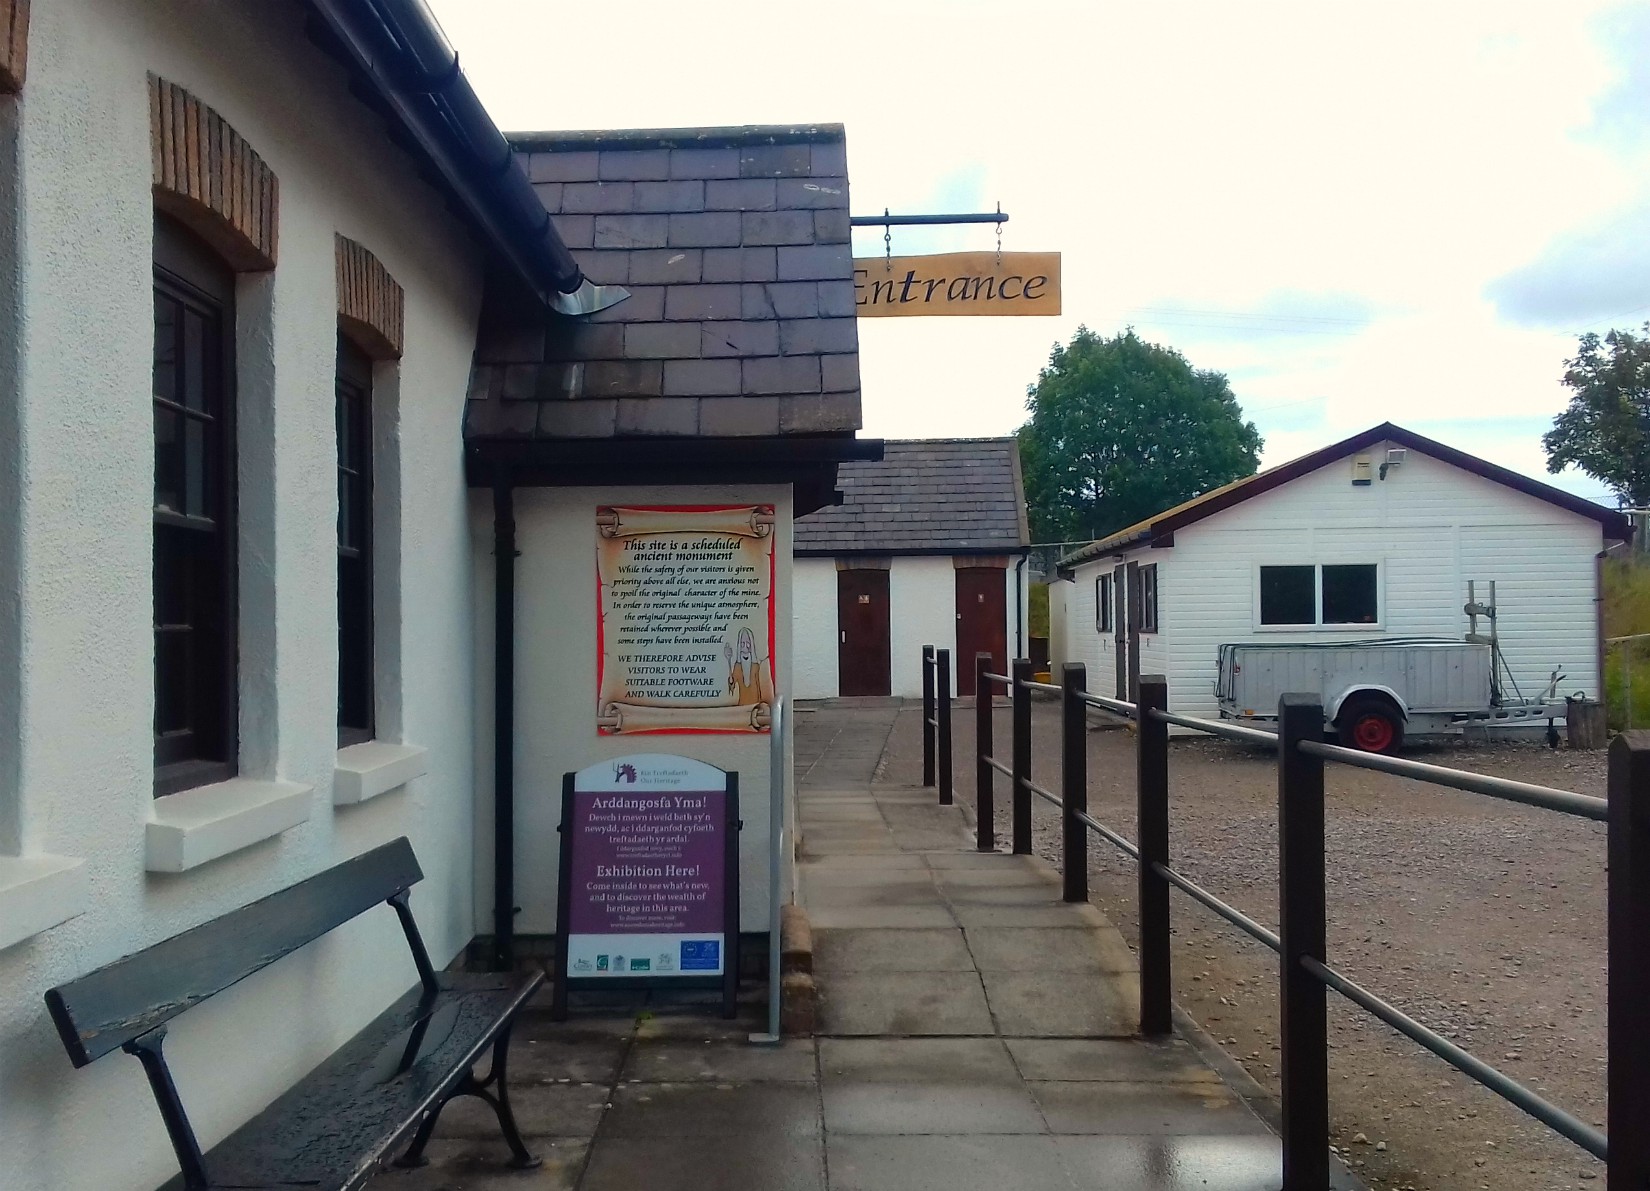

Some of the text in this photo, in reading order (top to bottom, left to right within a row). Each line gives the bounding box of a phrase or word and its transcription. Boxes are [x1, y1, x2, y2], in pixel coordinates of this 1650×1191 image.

[854, 270, 1047, 304] Entrance
[624, 538, 645, 551] This
[649, 540, 666, 550] site
[670, 540, 678, 550] is
[691, 538, 743, 550] scheduled
[633, 551, 733, 561] ancient monument
[619, 565, 640, 573] While
[642, 565, 652, 573] the
[654, 565, 675, 575] safety
[677, 565, 685, 574] of
[735, 566, 754, 574] given
[613, 578, 641, 588] priority
[644, 577, 664, 585] above
[677, 577, 691, 585] else,
[620, 589, 637, 599] spoil
[652, 589, 681, 599] original
[684, 588, 717, 596] character
[719, 588, 727, 598] of
[728, 588, 739, 596] the
[691, 602, 716, 611] unique
[718, 600, 759, 610] atmosphere,
[637, 613, 666, 622] original
[666, 614, 712, 623] passageways
[683, 624, 711, 634] possible
[637, 637, 653, 646] steps
[655, 636, 671, 644] have
[675, 636, 690, 644] been
[692, 636, 723, 644] installed.
[592, 797, 706, 811] Arddangosfa Yma!
[694, 813, 711, 822] sy'n
[585, 825, 619, 834] newydd,
[636, 825, 682, 833] ddarganfod
[684, 824, 714, 833] cyfoeth
[597, 865, 699, 876] Exhibition Here!
[612, 882, 637, 890] inside
[663, 882, 689, 890] what's
[697, 892, 706, 900] of
[606, 904, 640, 913] heritage
[652, 904, 667, 912] this
